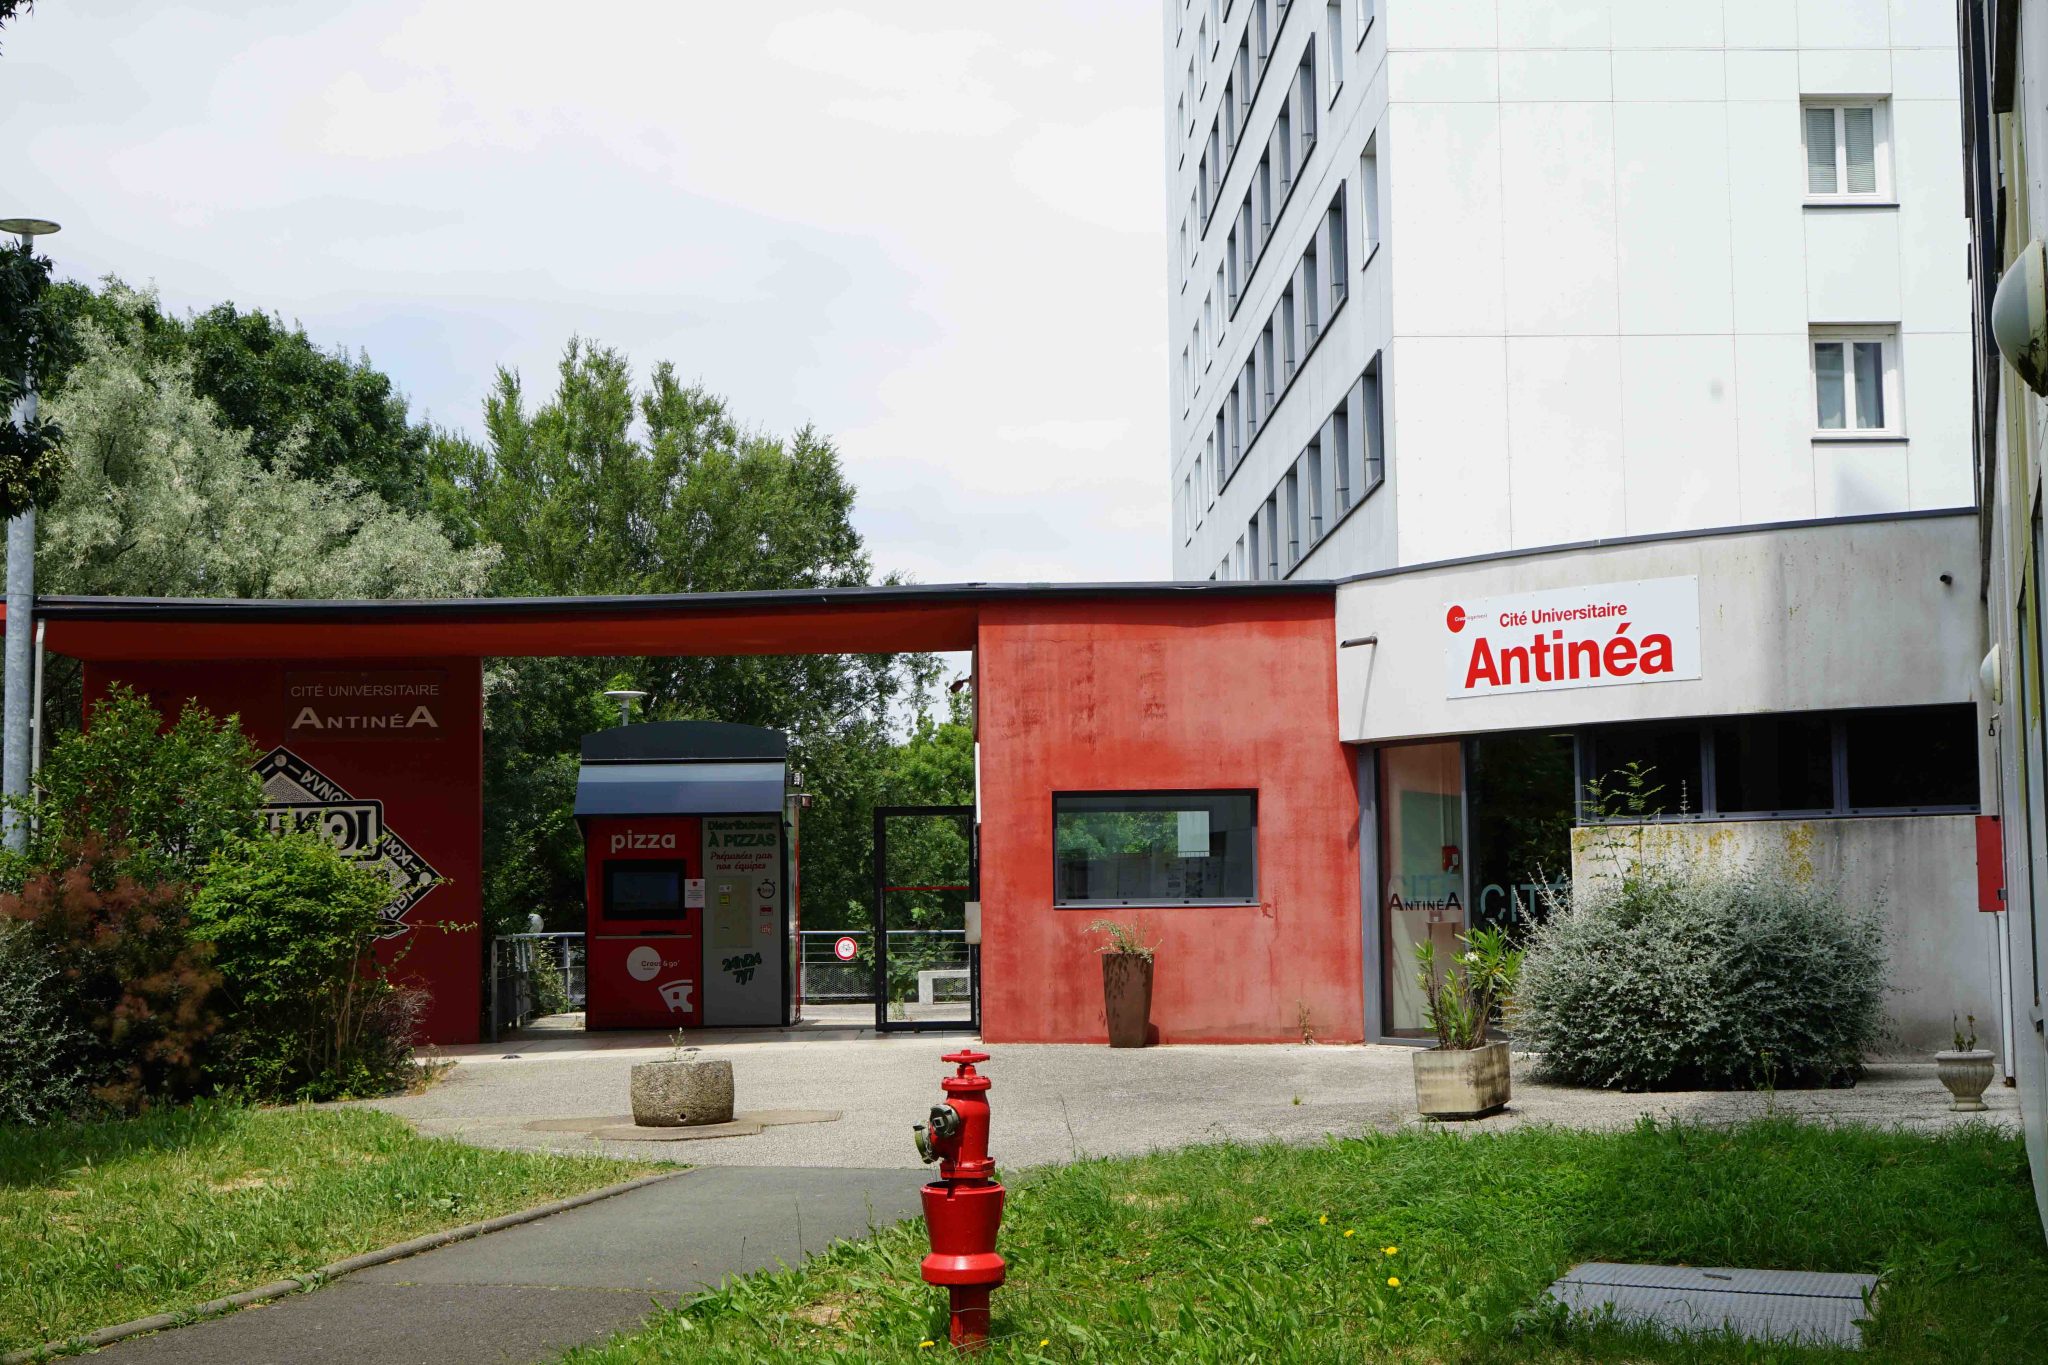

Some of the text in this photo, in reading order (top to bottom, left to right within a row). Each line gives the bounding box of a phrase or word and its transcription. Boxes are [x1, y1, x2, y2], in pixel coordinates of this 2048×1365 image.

[1499, 602, 1628, 628] Cité Universitaire
[1464, 622, 1674, 689] Antinéa
[290, 683, 440, 697] CITÉ UNIVERSITAIRE
[291, 704, 439, 729] ANTINÉA
[707, 820, 777, 831] Distributeur
[610, 829, 676, 854] pizza
[723, 833, 777, 848] PIZZAS
[710, 851, 773, 861] Préparées par
[734, 861, 767, 872] équipes
[1390, 892, 1463, 911] ANTINÉA
